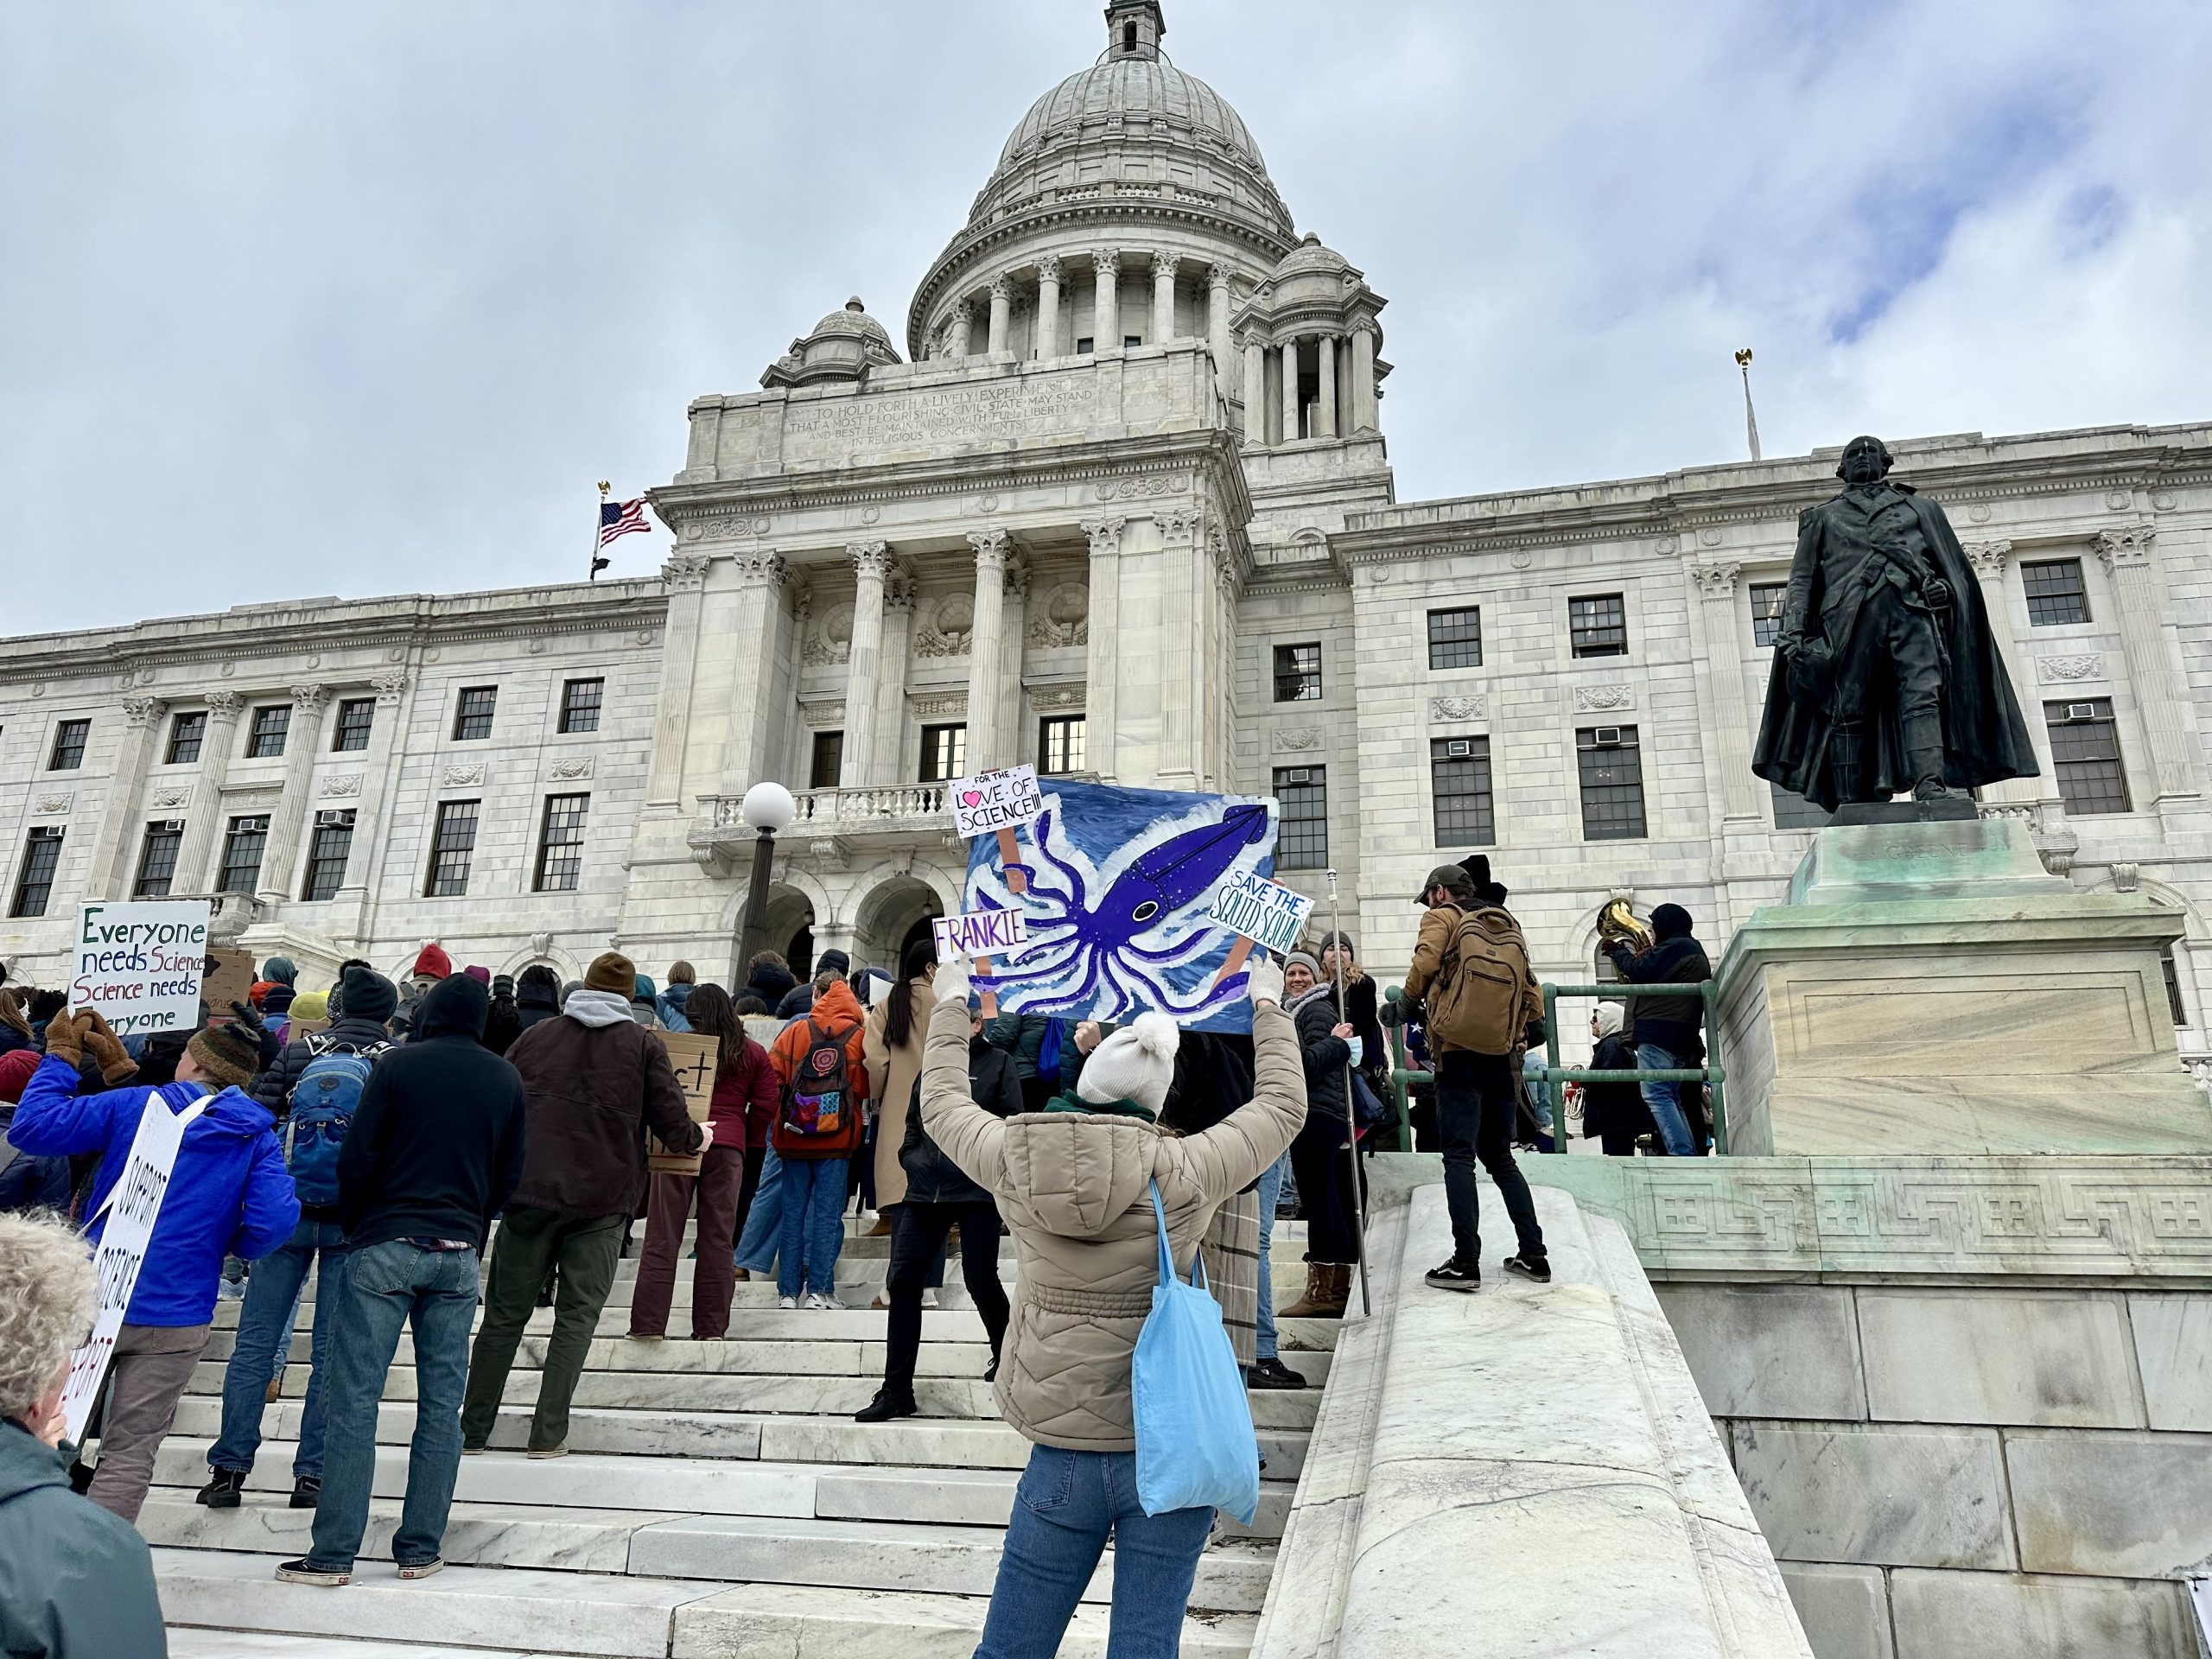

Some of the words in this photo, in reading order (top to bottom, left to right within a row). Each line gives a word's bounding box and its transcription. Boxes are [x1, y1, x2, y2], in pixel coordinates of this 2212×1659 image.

[790, 421, 820, 433] THAT
[822, 420, 830, 429] A
[834, 416, 865, 429] MOST
[868, 407, 950, 425] FLOURISHING
[953, 404, 983, 415] CIVIL
[988, 398, 1022, 411] STATE
[1028, 395, 1053, 406] MAY
[1057, 391, 1092, 403] STAND
[816, 409, 833, 419] TO
[838, 404, 874, 416] HOLD
[878, 398, 917, 413] FORTH
[920, 397, 929, 407] A
[932, 391, 974, 406] LIVELY
[980, 380, 1066, 401] EXPERIMENT
[809, 431, 831, 442] AND
[836, 427, 861, 438] BEST
[868, 425, 880, 435] BE
[886, 417, 954, 433] MAINTAINED
[958, 413, 987, 425] WITH
[993, 410, 1020, 420] FULL
[1024, 404, 1070, 417] LIBERTY
[852, 437, 863, 448] IN
[868, 432, 924, 445] RELIGIOUS
[974, 775, 991, 785] FOR
[992, 770, 1010, 781] THE
[1012, 777, 1032, 797] OF
[1230, 870, 1273, 902] SAVE
[1274, 888, 1306, 918] THE
[82, 907, 206, 944] Everyone
[933, 908, 1028, 957] FRANKIE
[1210, 885, 1262, 934] SQUID
[1254, 906, 1302, 954] SQUAD
[81, 944, 148, 974] needs
[149, 946, 206, 973] Science
[73, 975, 143, 1004] Science
[149, 972, 198, 997] needs
